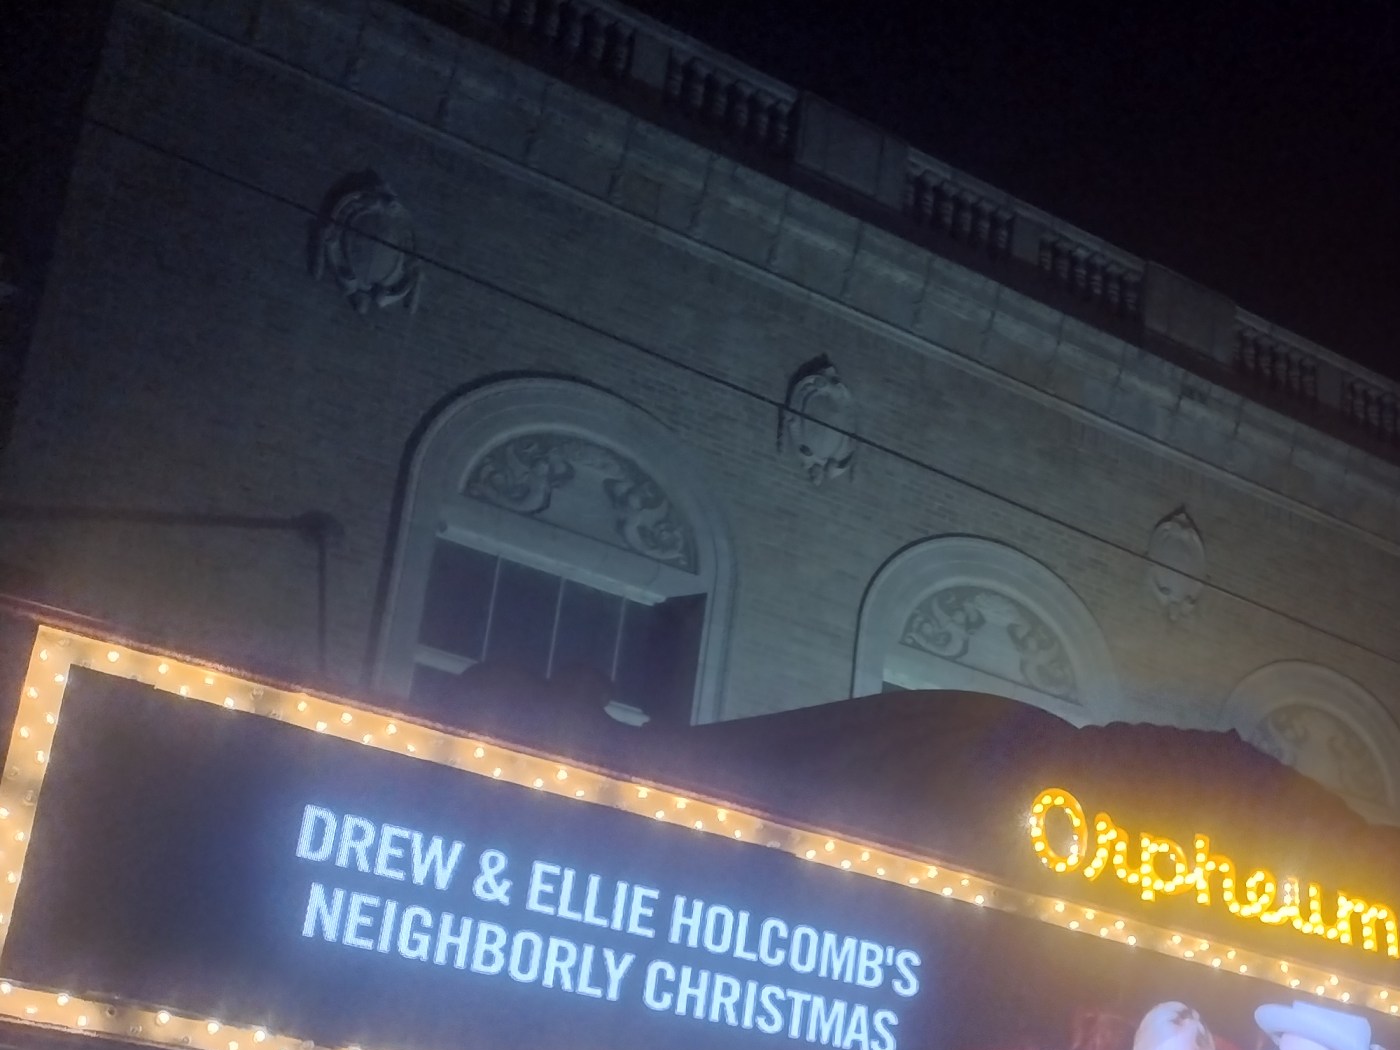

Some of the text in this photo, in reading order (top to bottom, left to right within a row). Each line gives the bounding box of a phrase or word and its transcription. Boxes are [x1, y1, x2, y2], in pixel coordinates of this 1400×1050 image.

[296, 803, 922, 998] DREW & ELLIE HOLCOMB'S
[301, 881, 636, 1002] NEIGHBORLY
[1029, 788, 1400, 960] Orpheum
